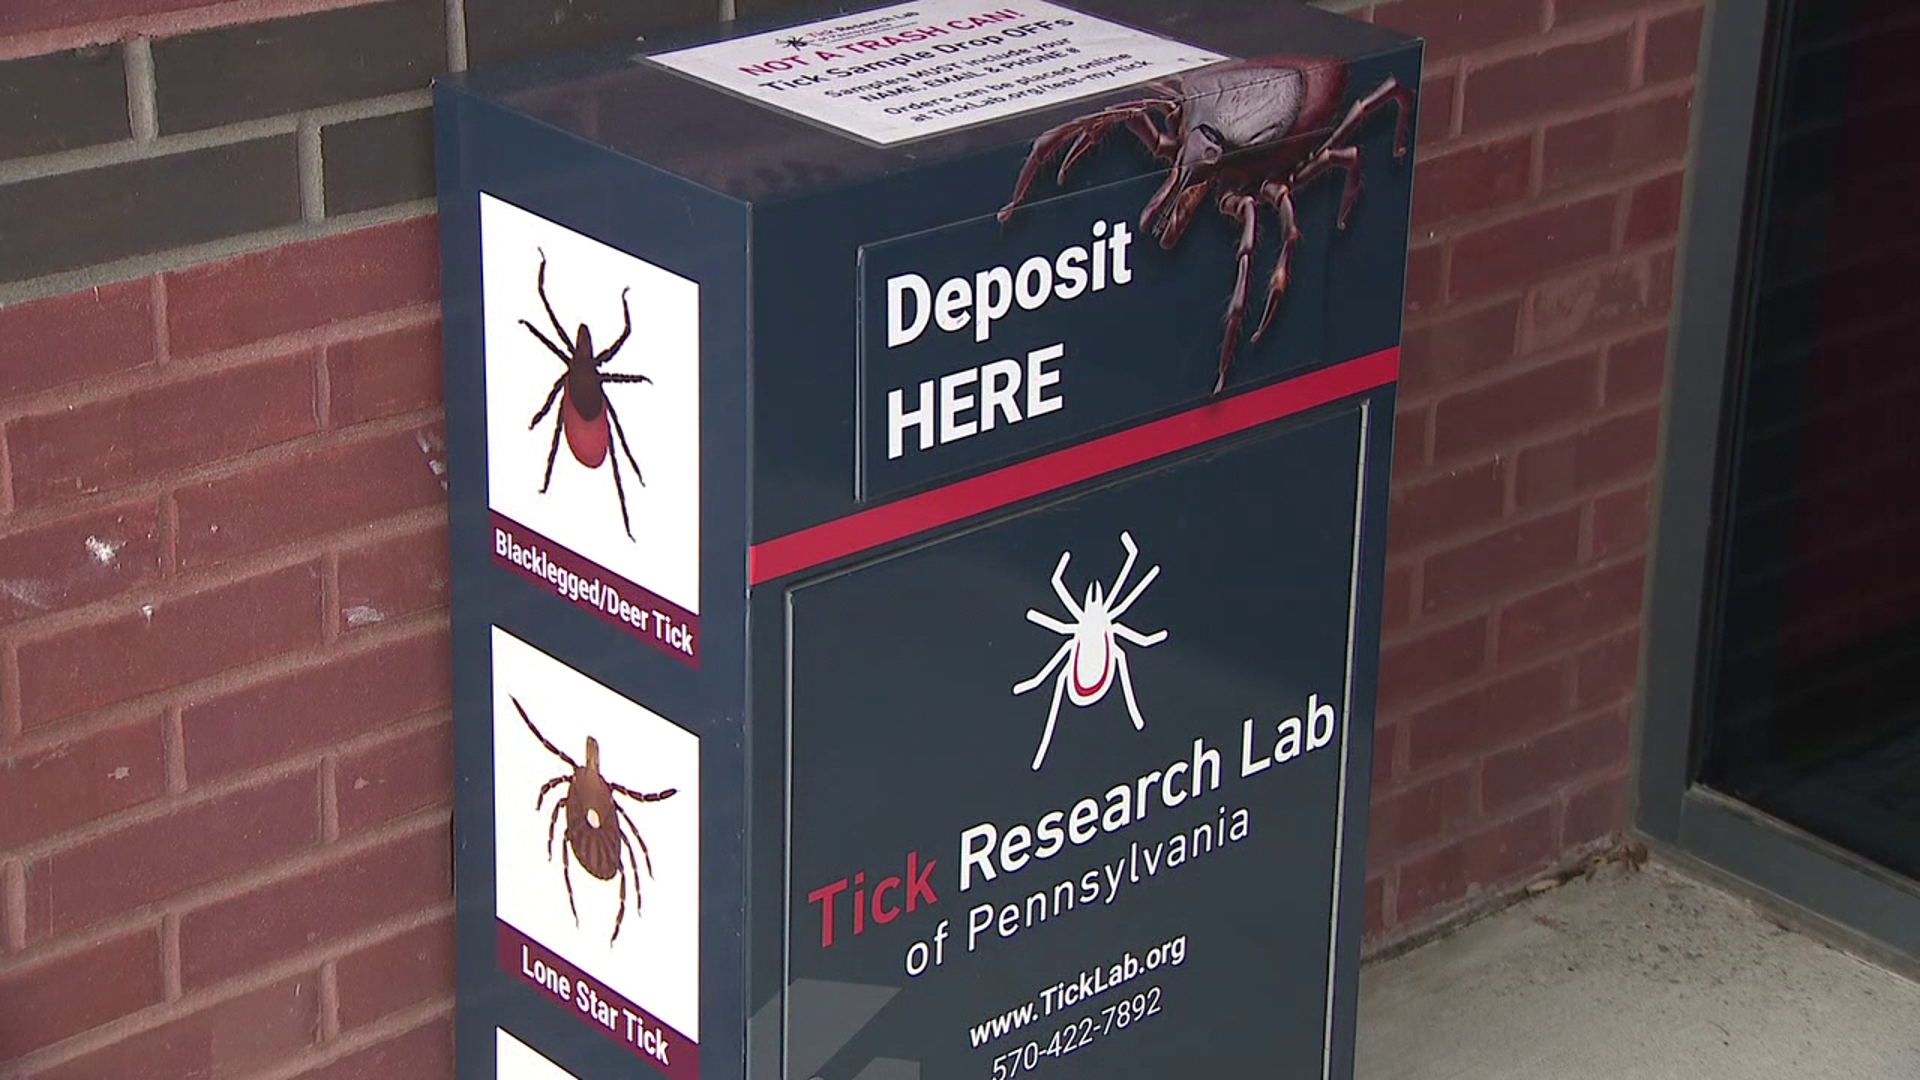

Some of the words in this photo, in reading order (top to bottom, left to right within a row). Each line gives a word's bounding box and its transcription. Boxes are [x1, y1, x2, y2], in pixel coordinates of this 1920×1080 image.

[738, 55, 810, 77] NOT
[815, 50, 846, 62] A
[837, 25, 949, 54] TRASH
[947, 8, 1026, 31] CAN!
[758, 72, 830, 92] Tick
[826, 50, 935, 79] Sample
[931, 34, 1004, 54] Drop
[1001, 18, 1074, 38] OFFs
[825, 76, 909, 98] Samples
[907, 62, 963, 79] MUST
[960, 47, 1032, 67] include
[1030, 37, 1071, 52] your
[860, 84, 928, 103] NAME,
[923, 71, 988, 89] EMAIL
[1000, 50, 1069, 71] PHONE
[884, 96, 953, 116] Orders
[953, 87, 986, 100] can
[985, 81, 1014, 92] be
[1015, 65, 1075, 87] placed
[1076, 53, 1133, 70] online
[911, 113, 933, 123] at
[887, 219, 1133, 349] Deposit
[887, 342, 1065, 461] HERE
[494, 527, 650, 632] Blacklegged/Deer
[651, 608, 694, 656] Tick
[808, 850, 938, 949] Tick
[958, 737, 1221, 892] Research
[1241, 692, 1336, 779] Lab
[905, 919, 950, 977] of
[967, 805, 1251, 952] Pennsylvania
[521, 943, 571, 1001] Lone
[575, 980, 620, 1032] Star
[622, 1007, 670, 1066] Tick
[968, 934, 1187, 1048] www.TickLab.org
[991, 986, 1163, 1080] 570-422-7892
